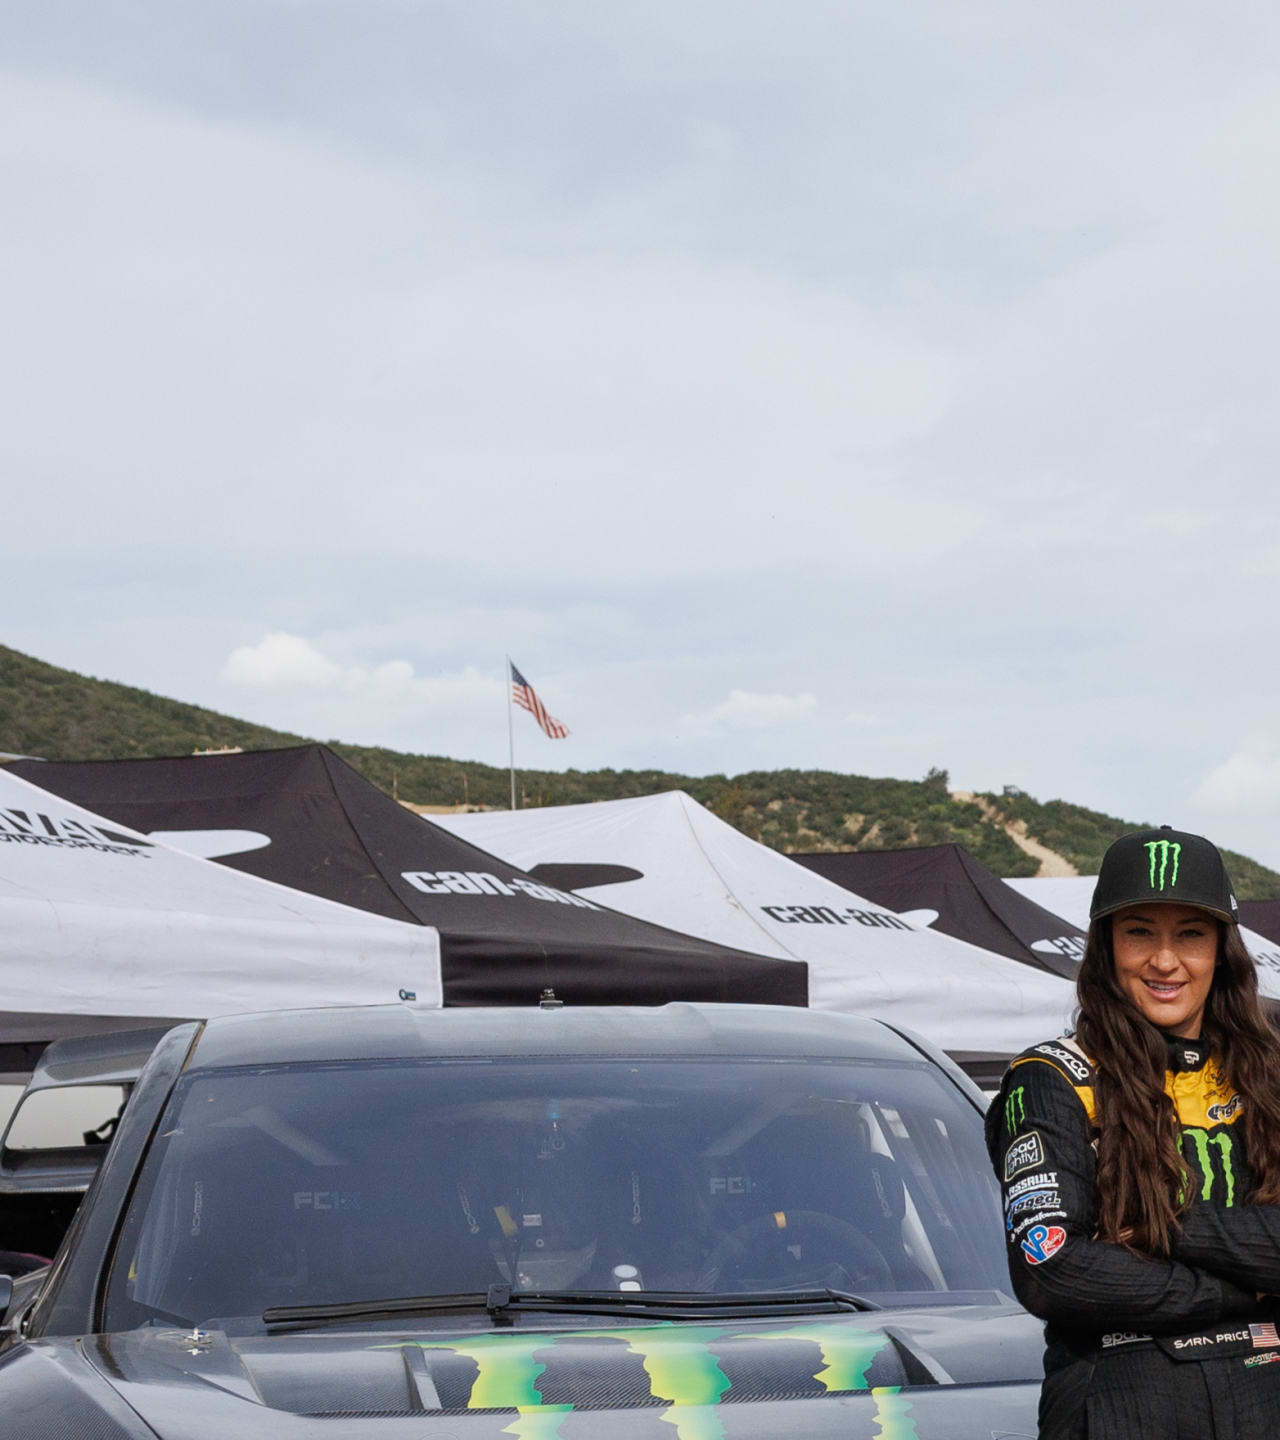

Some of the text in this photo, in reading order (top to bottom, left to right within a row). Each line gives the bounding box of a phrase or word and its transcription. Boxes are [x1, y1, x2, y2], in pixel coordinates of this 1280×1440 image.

[761, 905, 918, 932] can-am
[1035, 1045, 1089, 1080] sparco
[1009, 1171, 1058, 1197] ASSAULT
[1021, 1225, 1049, 1263] VP
[1216, 1330, 1250, 1344] PRICE
